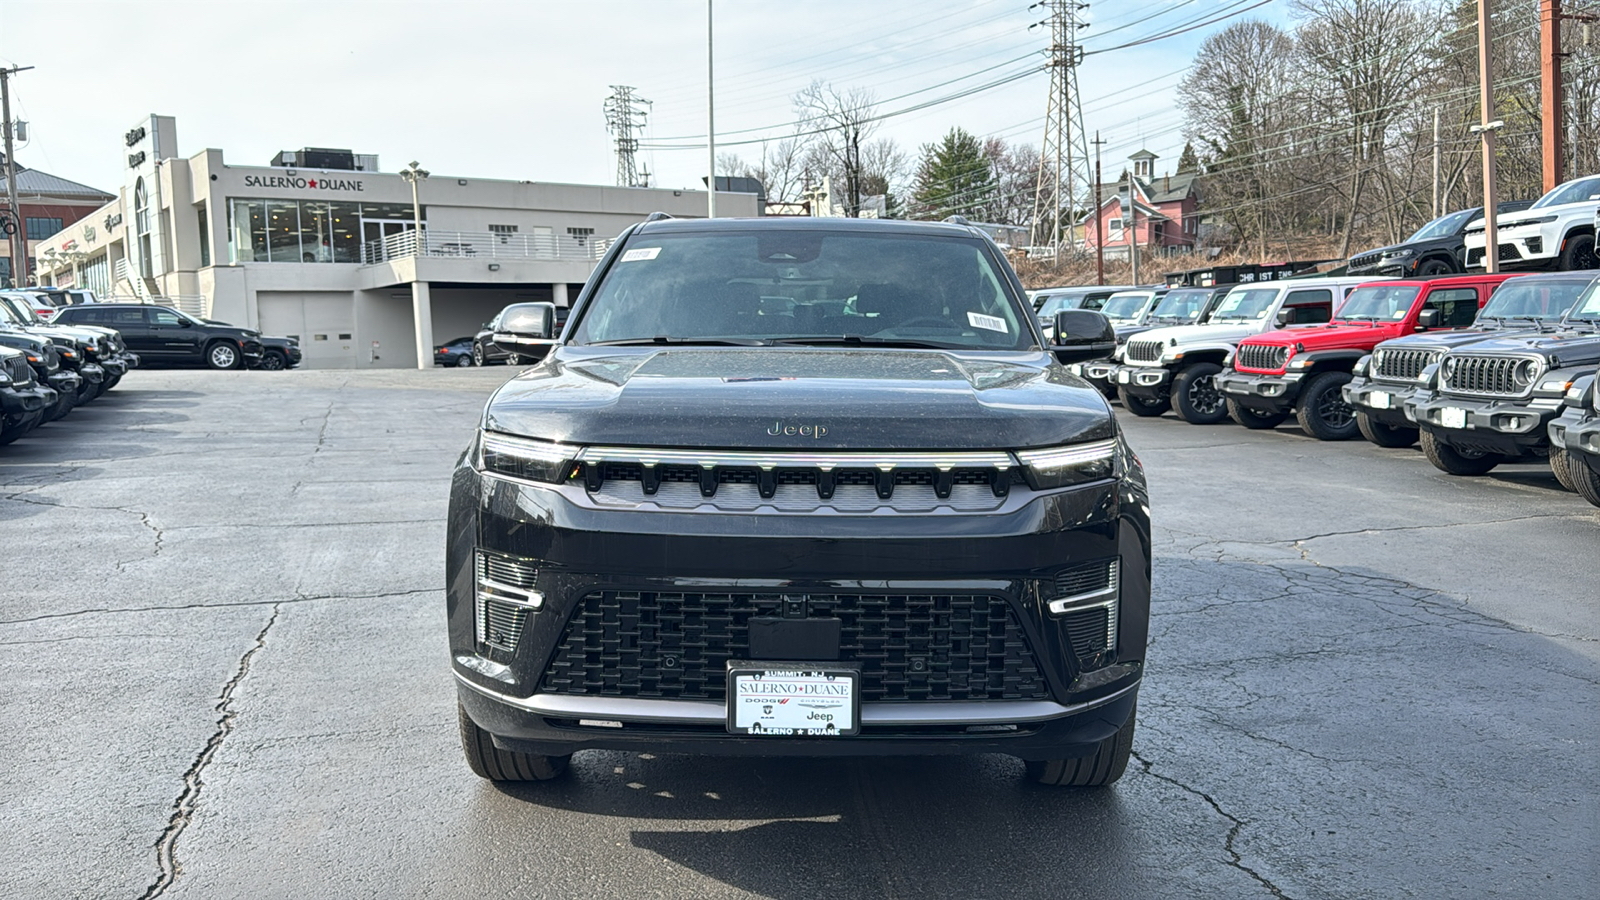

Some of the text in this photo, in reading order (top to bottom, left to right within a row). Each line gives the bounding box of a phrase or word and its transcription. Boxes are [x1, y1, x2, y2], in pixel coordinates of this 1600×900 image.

[245, 175, 364, 192] SALERNO DUANE
[766, 421, 829, 439] Jeep
[740, 682, 849, 696] SALERNO DUANE
[806, 711, 834, 722] Jeep
[747, 727, 841, 736] SALERNO DUANE
